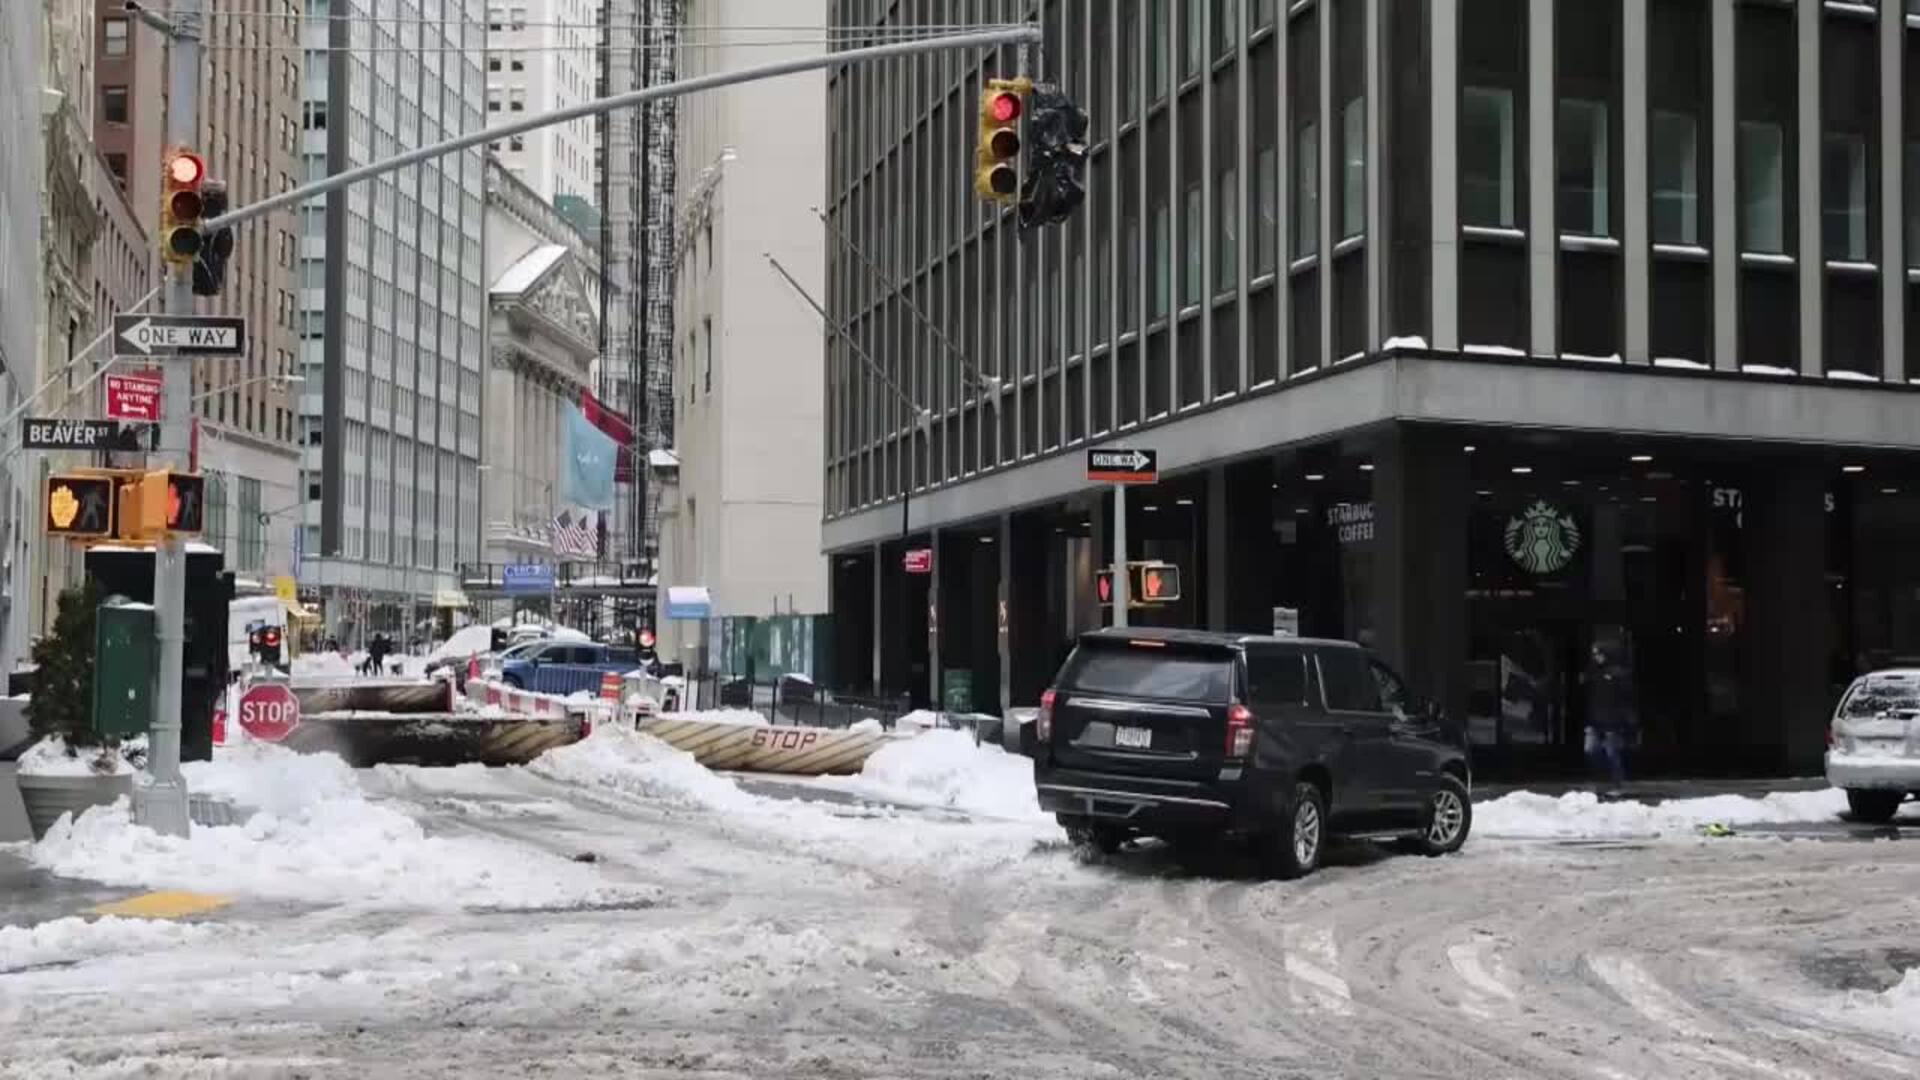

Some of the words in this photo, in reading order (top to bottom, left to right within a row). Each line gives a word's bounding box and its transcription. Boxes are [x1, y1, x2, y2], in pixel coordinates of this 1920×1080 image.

[139, 327, 177, 344] ONE
[189, 329, 227, 345] WAY
[109, 380, 121, 390] NO
[123, 381, 159, 394] STANDING
[116, 392, 154, 405] ANYTIME
[29, 424, 96, 445] BEAVER
[98, 427, 109, 437] ST
[1121, 455, 1142, 466] WAY
[243, 700, 296, 722] STOP
[752, 728, 817, 750] STOP
